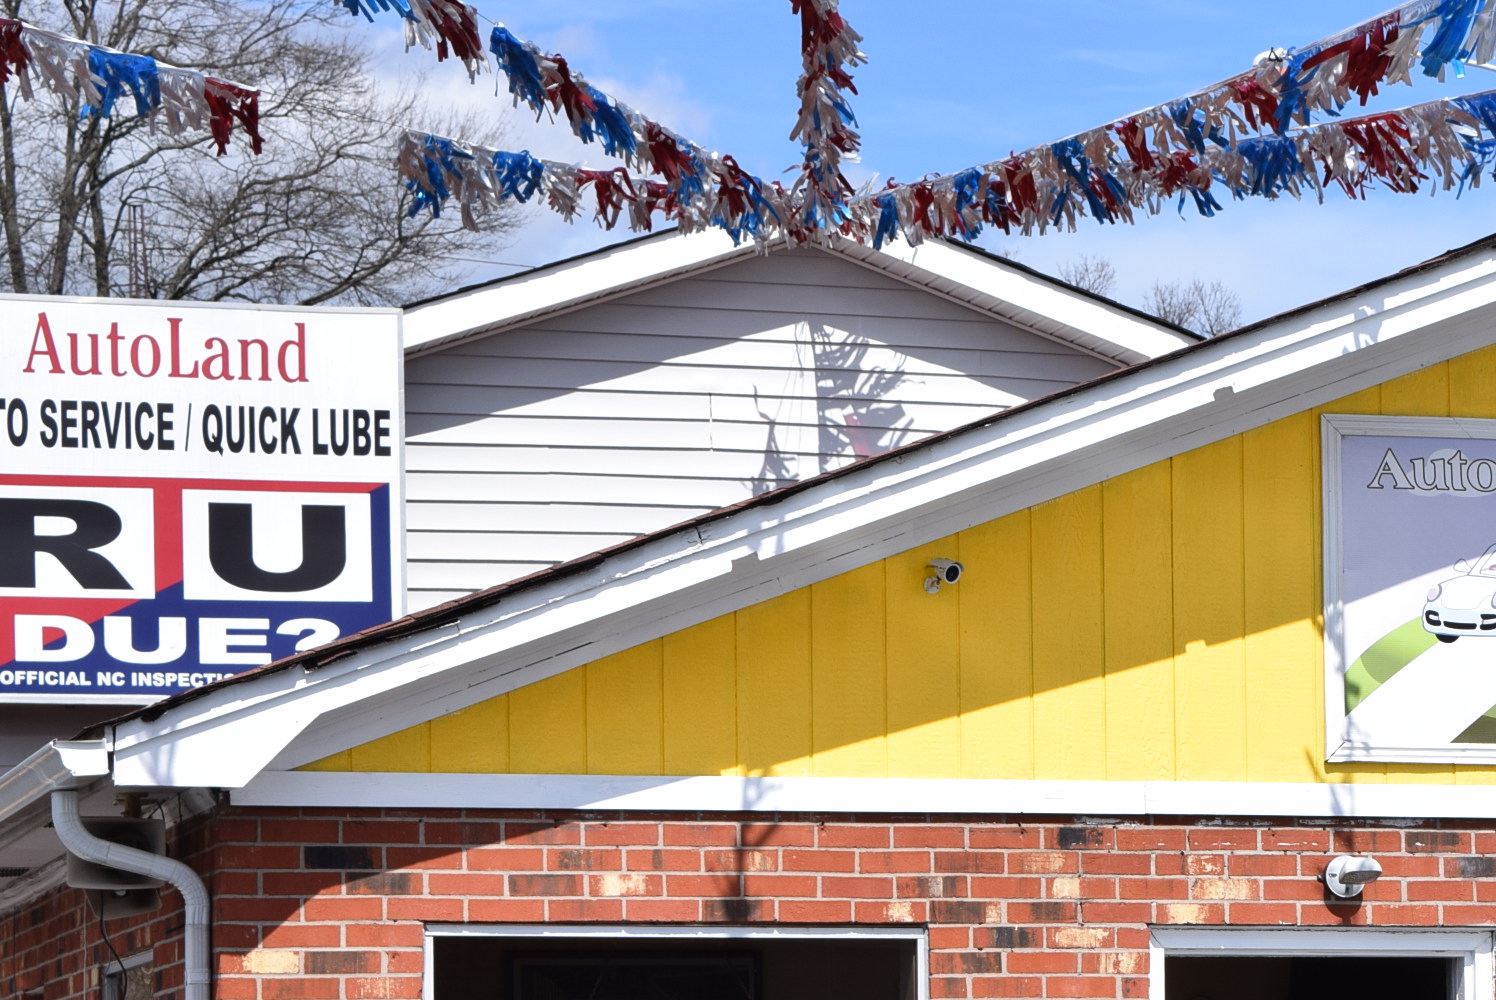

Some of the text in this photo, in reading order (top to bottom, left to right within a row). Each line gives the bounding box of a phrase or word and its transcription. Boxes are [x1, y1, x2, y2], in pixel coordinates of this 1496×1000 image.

[23, 312, 309, 382] AutoLand
[40, 399, 175, 451] SERVICE
[202, 404, 302, 456] QUICK
[312, 408, 392, 457] LUBE
[0, 498, 346, 593] R U
[14, 614, 341, 665] DUE?
[0, 670, 234, 688] OFFICIAL NC INSPECTI
